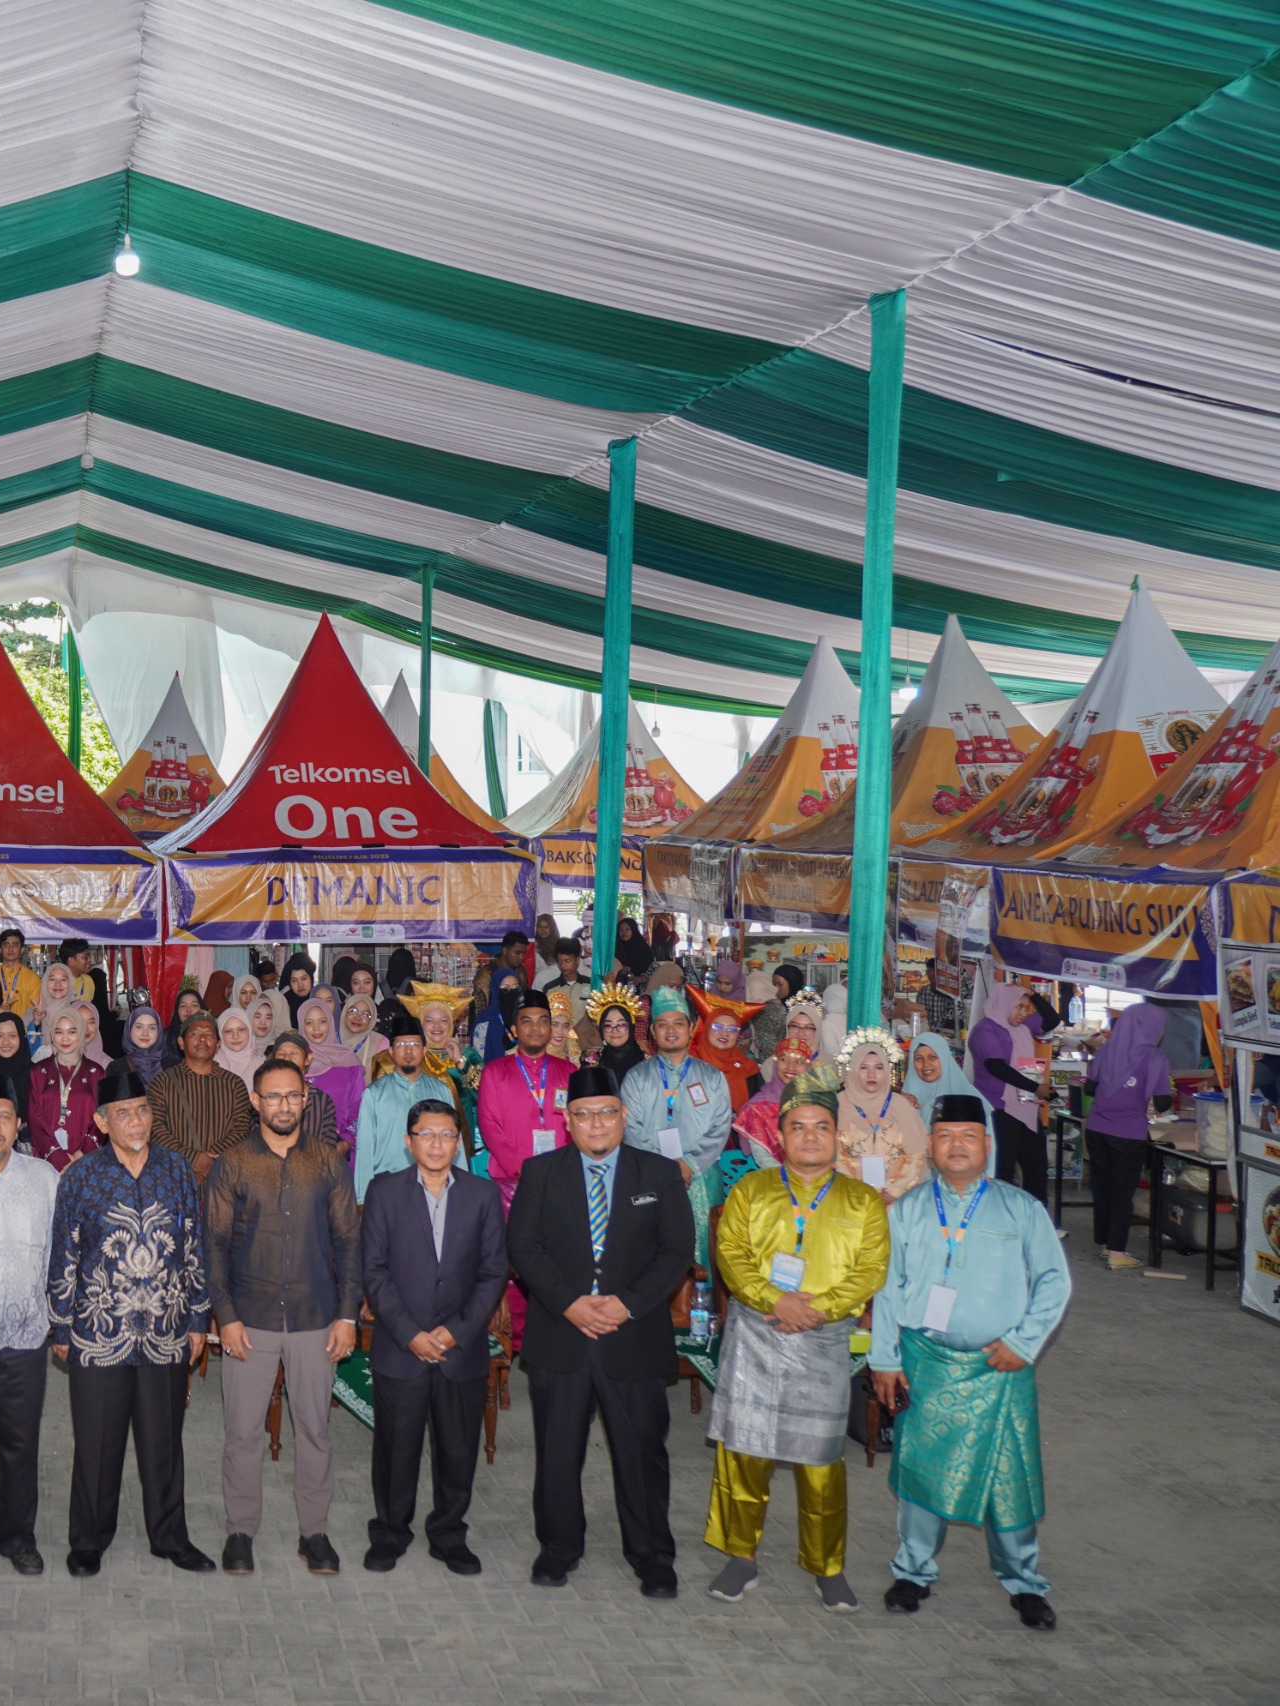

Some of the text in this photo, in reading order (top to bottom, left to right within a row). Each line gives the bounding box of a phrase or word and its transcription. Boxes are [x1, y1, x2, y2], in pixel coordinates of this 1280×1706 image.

[268, 762, 411, 786] Telkomsel
[274, 795, 419, 839] One
[546, 849, 597, 864] BAKSO
[266, 876, 441, 906] DEMANIC
[1003, 890, 1067, 926] ANEKA
[1070, 895, 1142, 936] PUDING
